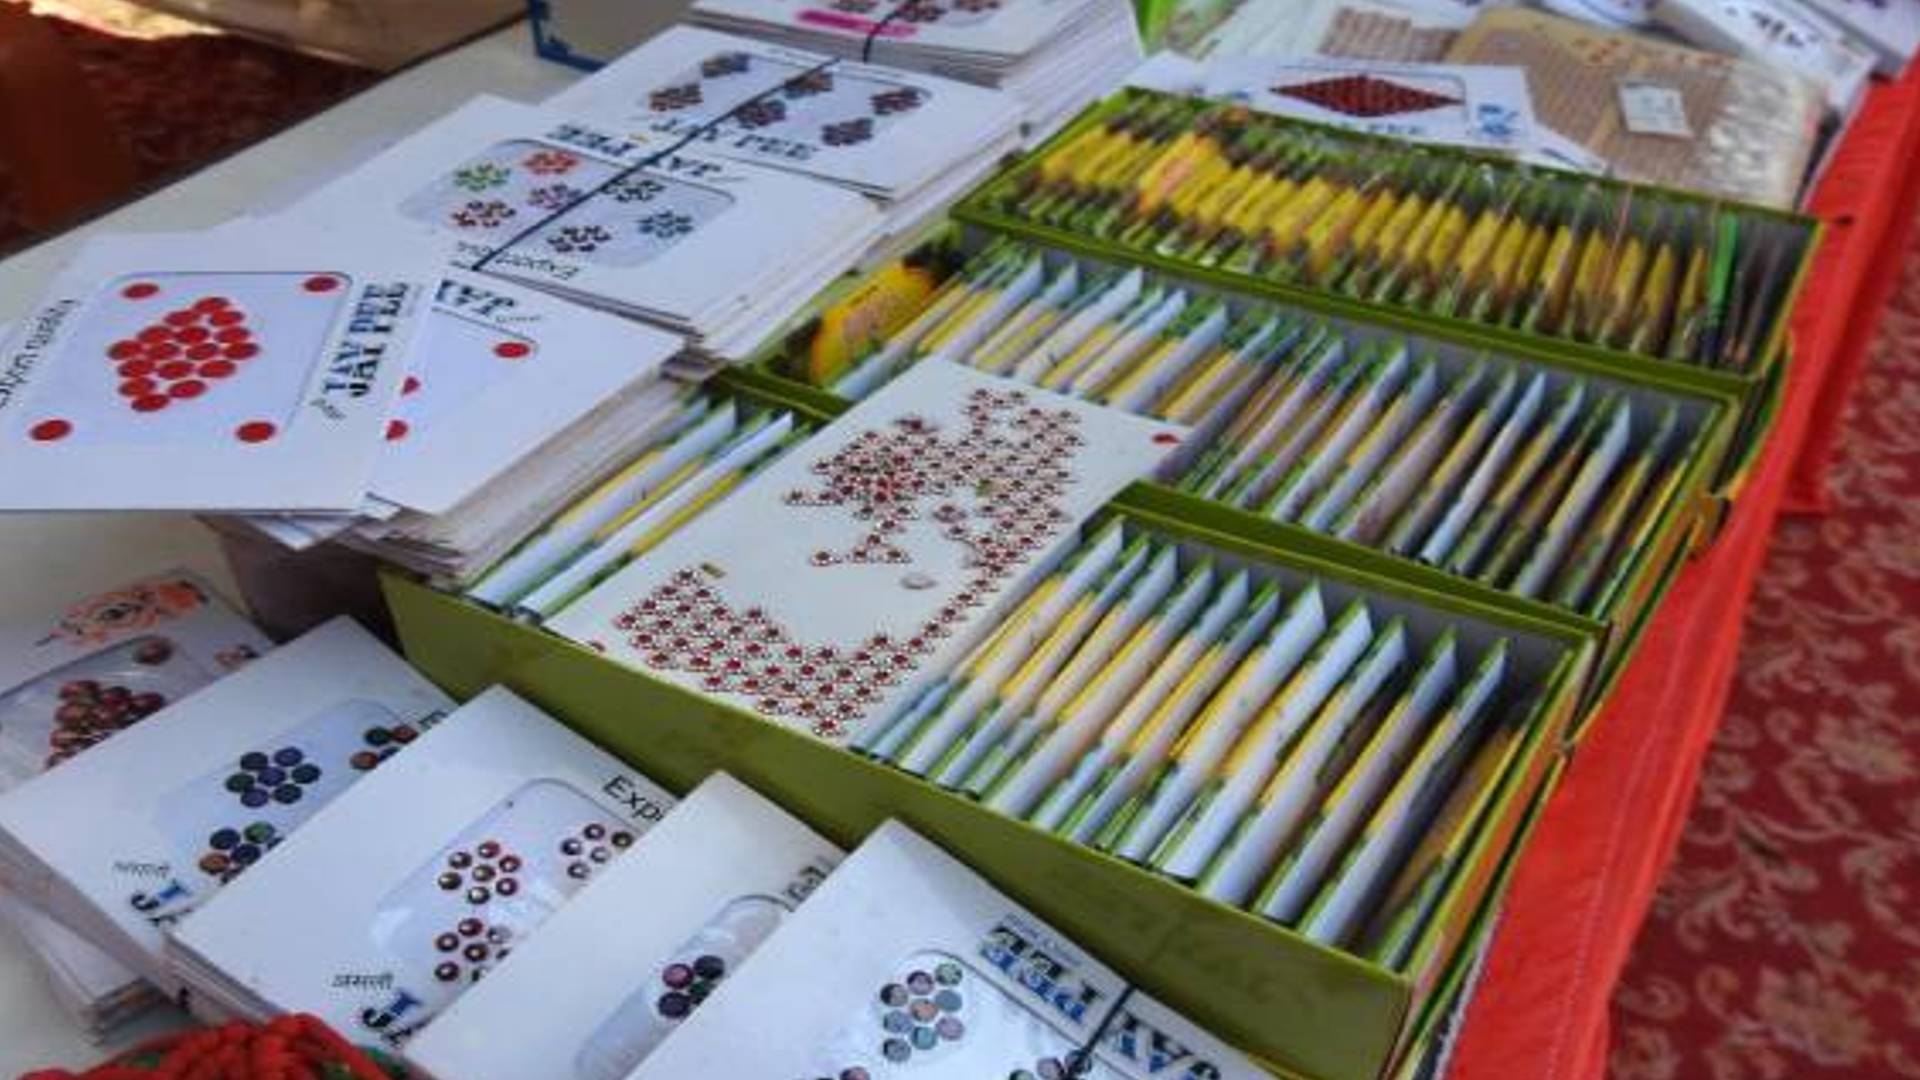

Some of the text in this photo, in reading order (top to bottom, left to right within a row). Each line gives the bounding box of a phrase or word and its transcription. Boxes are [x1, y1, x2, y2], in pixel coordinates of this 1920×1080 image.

[349, 281, 409, 333] PEE
[322, 342, 387, 398] JAY
[602, 773, 666, 823] Exp
[980, 925, 1102, 1025] PEE
